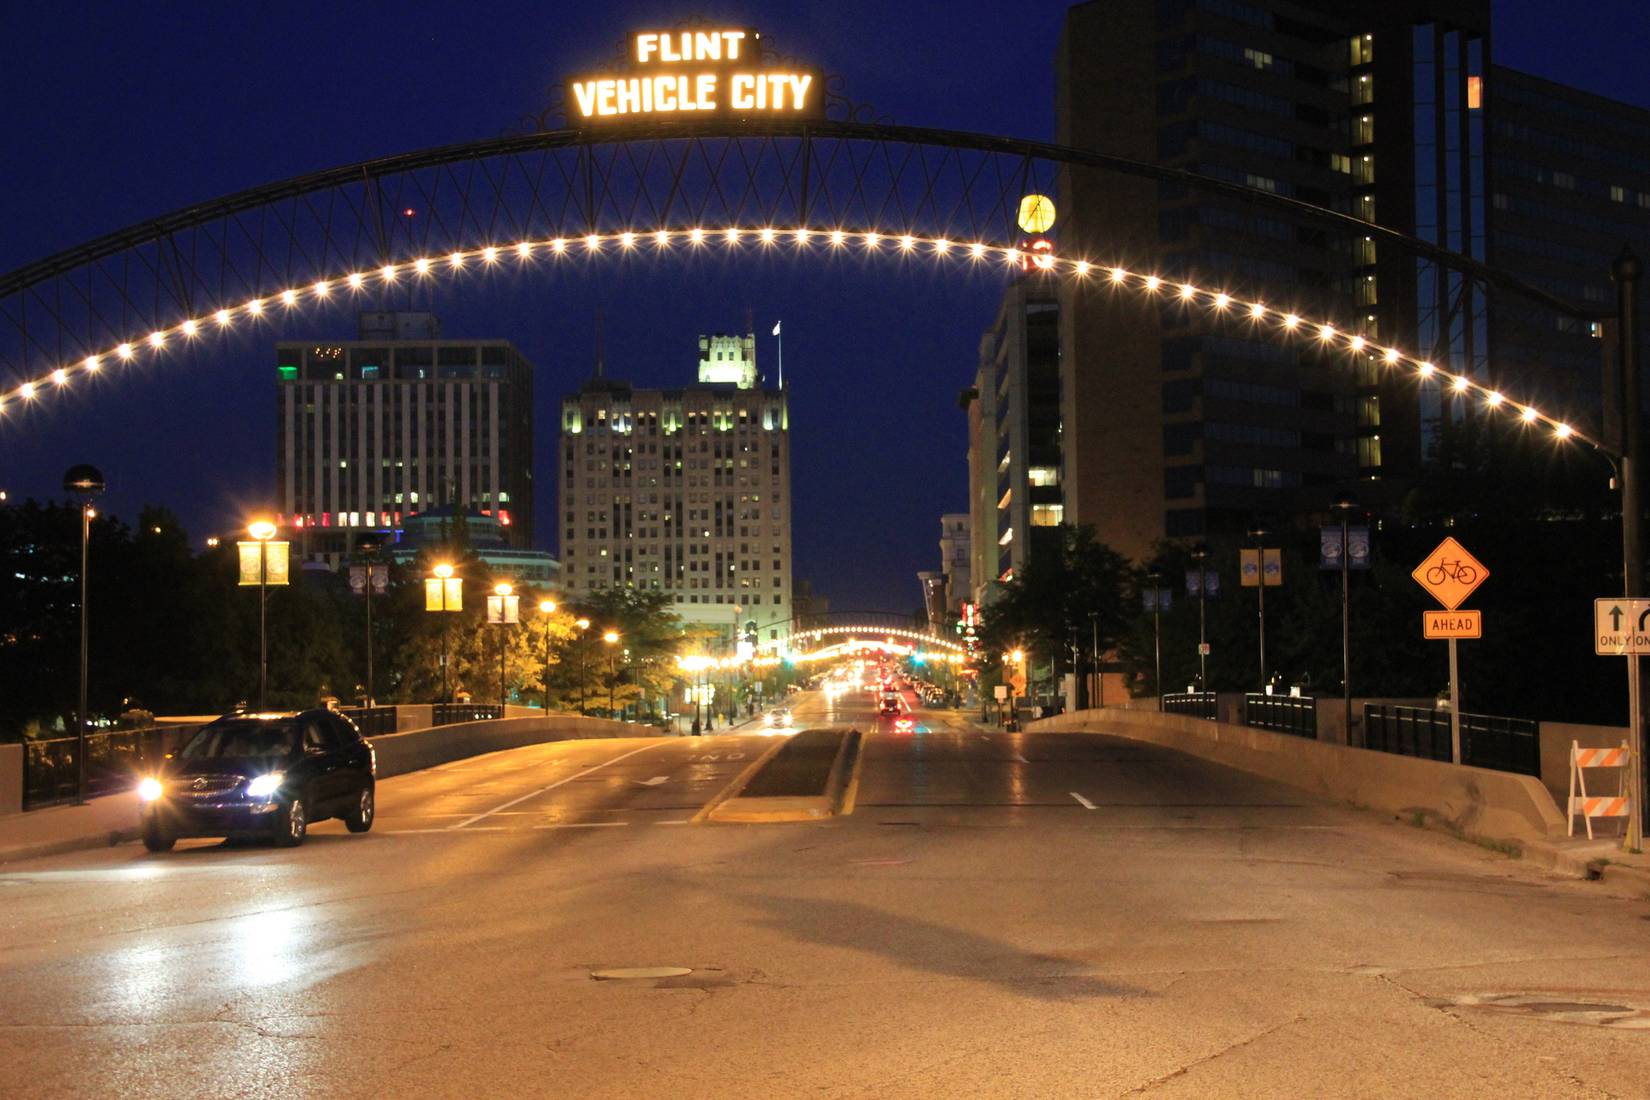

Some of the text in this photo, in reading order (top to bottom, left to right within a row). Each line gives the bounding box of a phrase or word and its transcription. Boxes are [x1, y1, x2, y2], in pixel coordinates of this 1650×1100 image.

[637, 31, 746, 63] FLINT
[572, 73, 813, 117] VEHICLE CITY
[1432, 618, 1473, 631] AHEAD
[1600, 635, 1631, 646] ONLY
